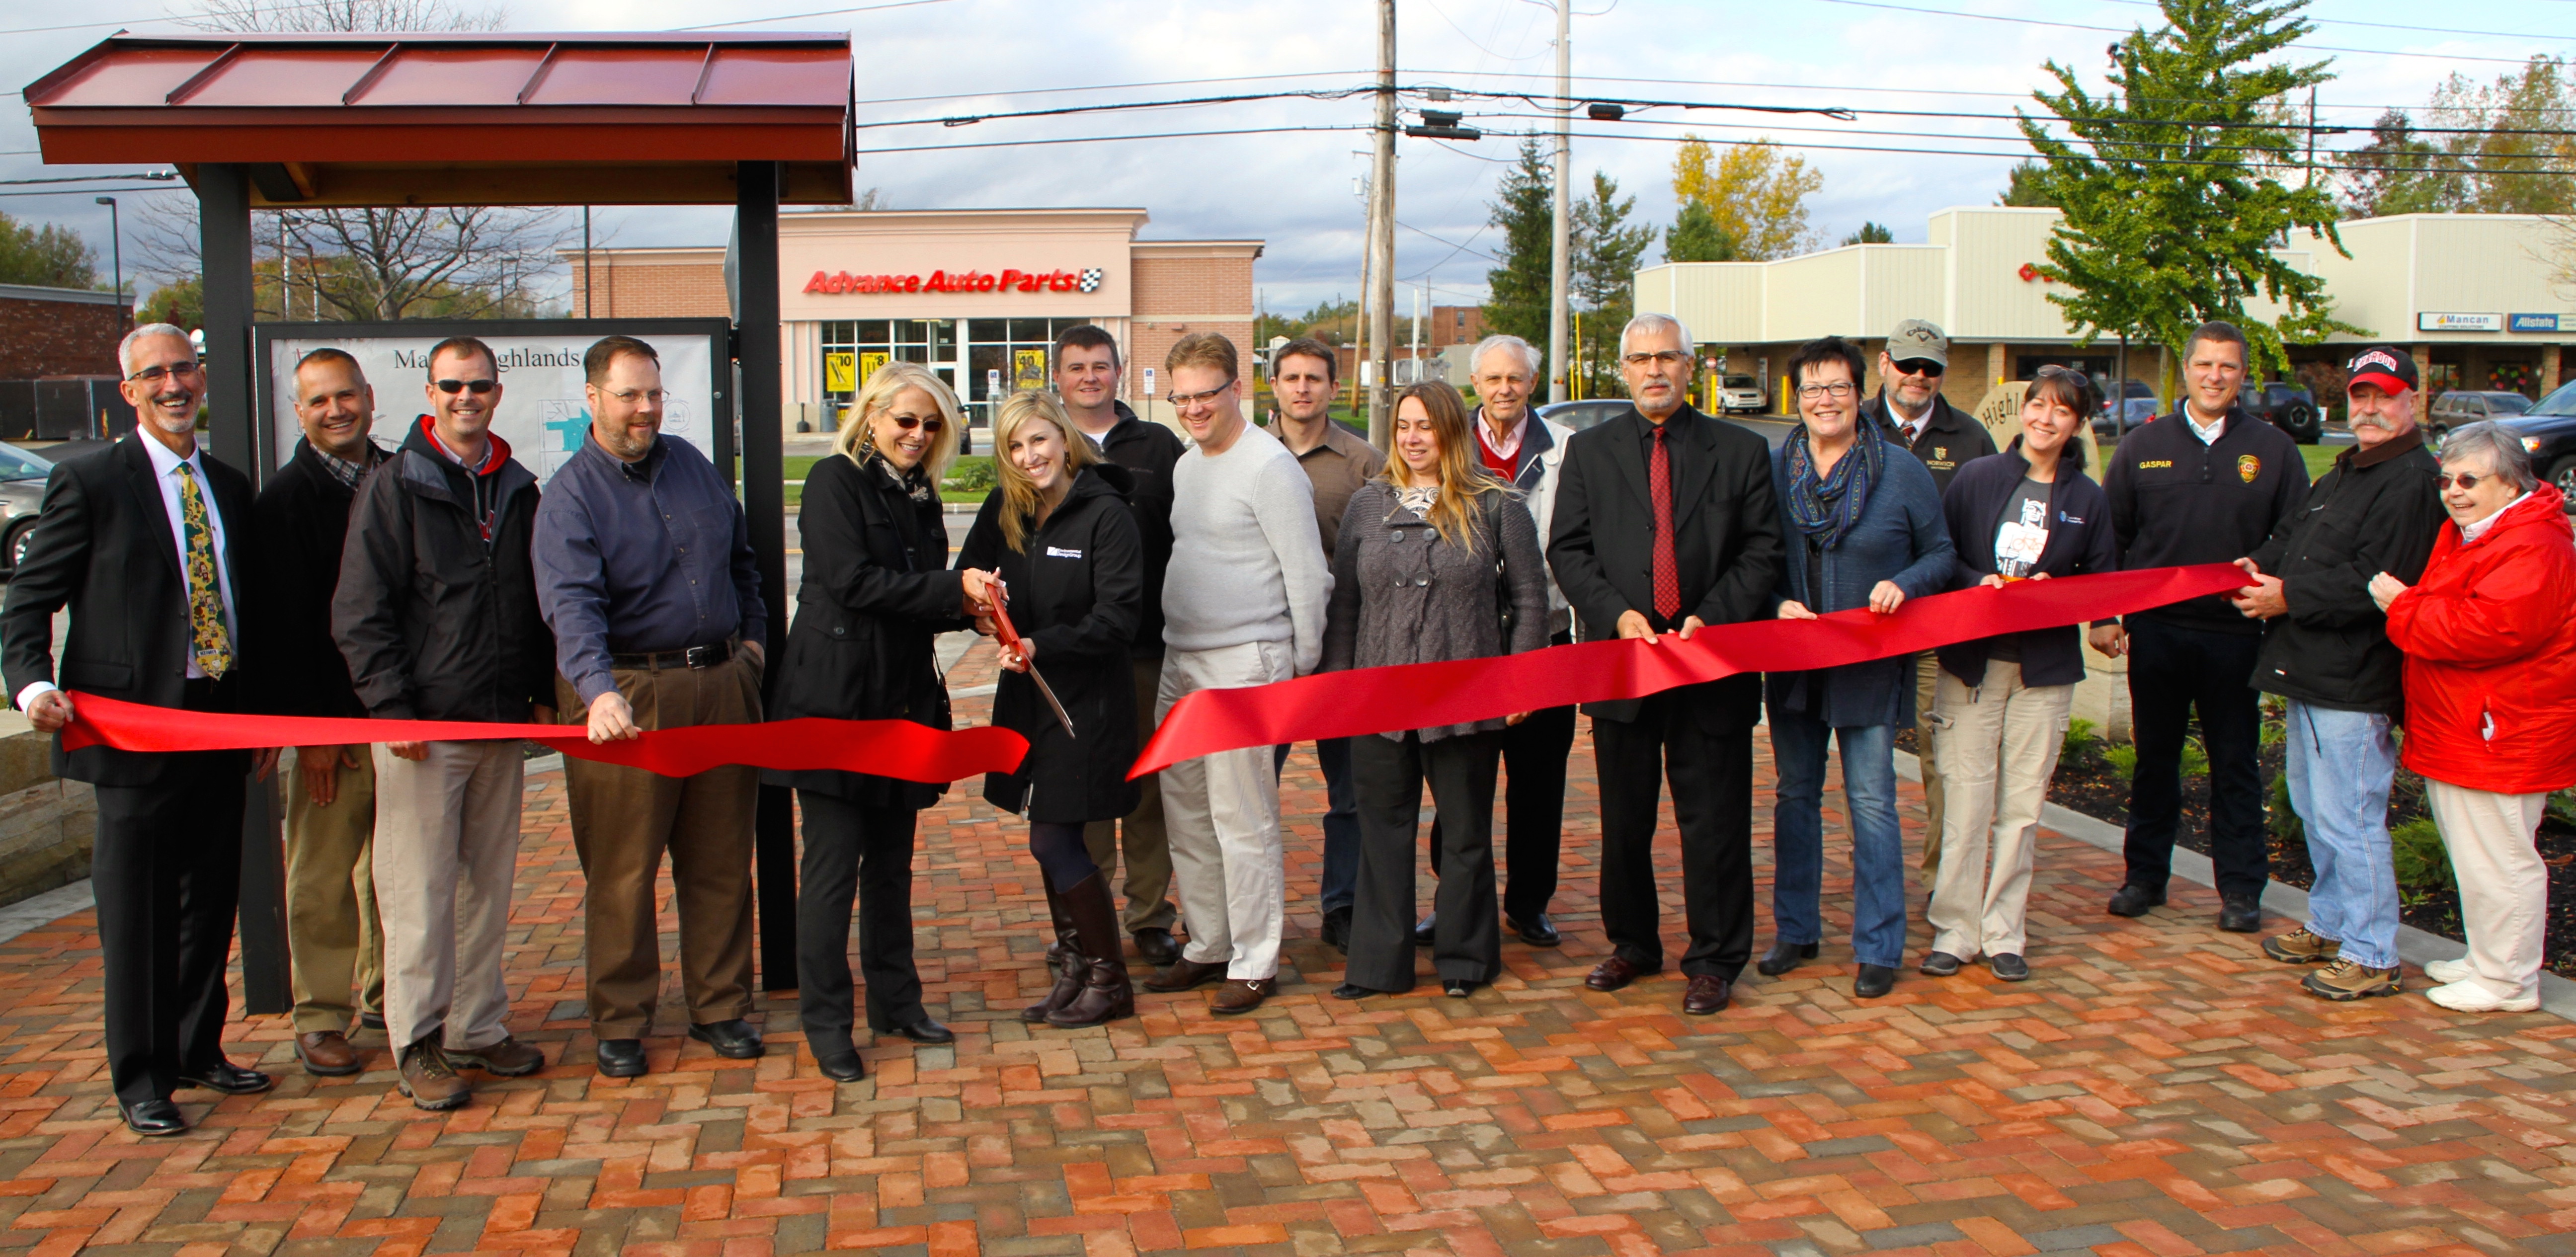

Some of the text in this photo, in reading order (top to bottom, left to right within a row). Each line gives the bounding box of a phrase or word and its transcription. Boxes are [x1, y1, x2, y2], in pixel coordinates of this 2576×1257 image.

[802, 268, 1075, 293] Advance Auto Parts
[2446, 315, 2489, 323] Mancan
[2515, 316, 2555, 327] Allstate
[497, 347, 580, 373] ghlands
[1982, 392, 2019, 430] Highl
[2139, 461, 2172, 469] GASPAR
